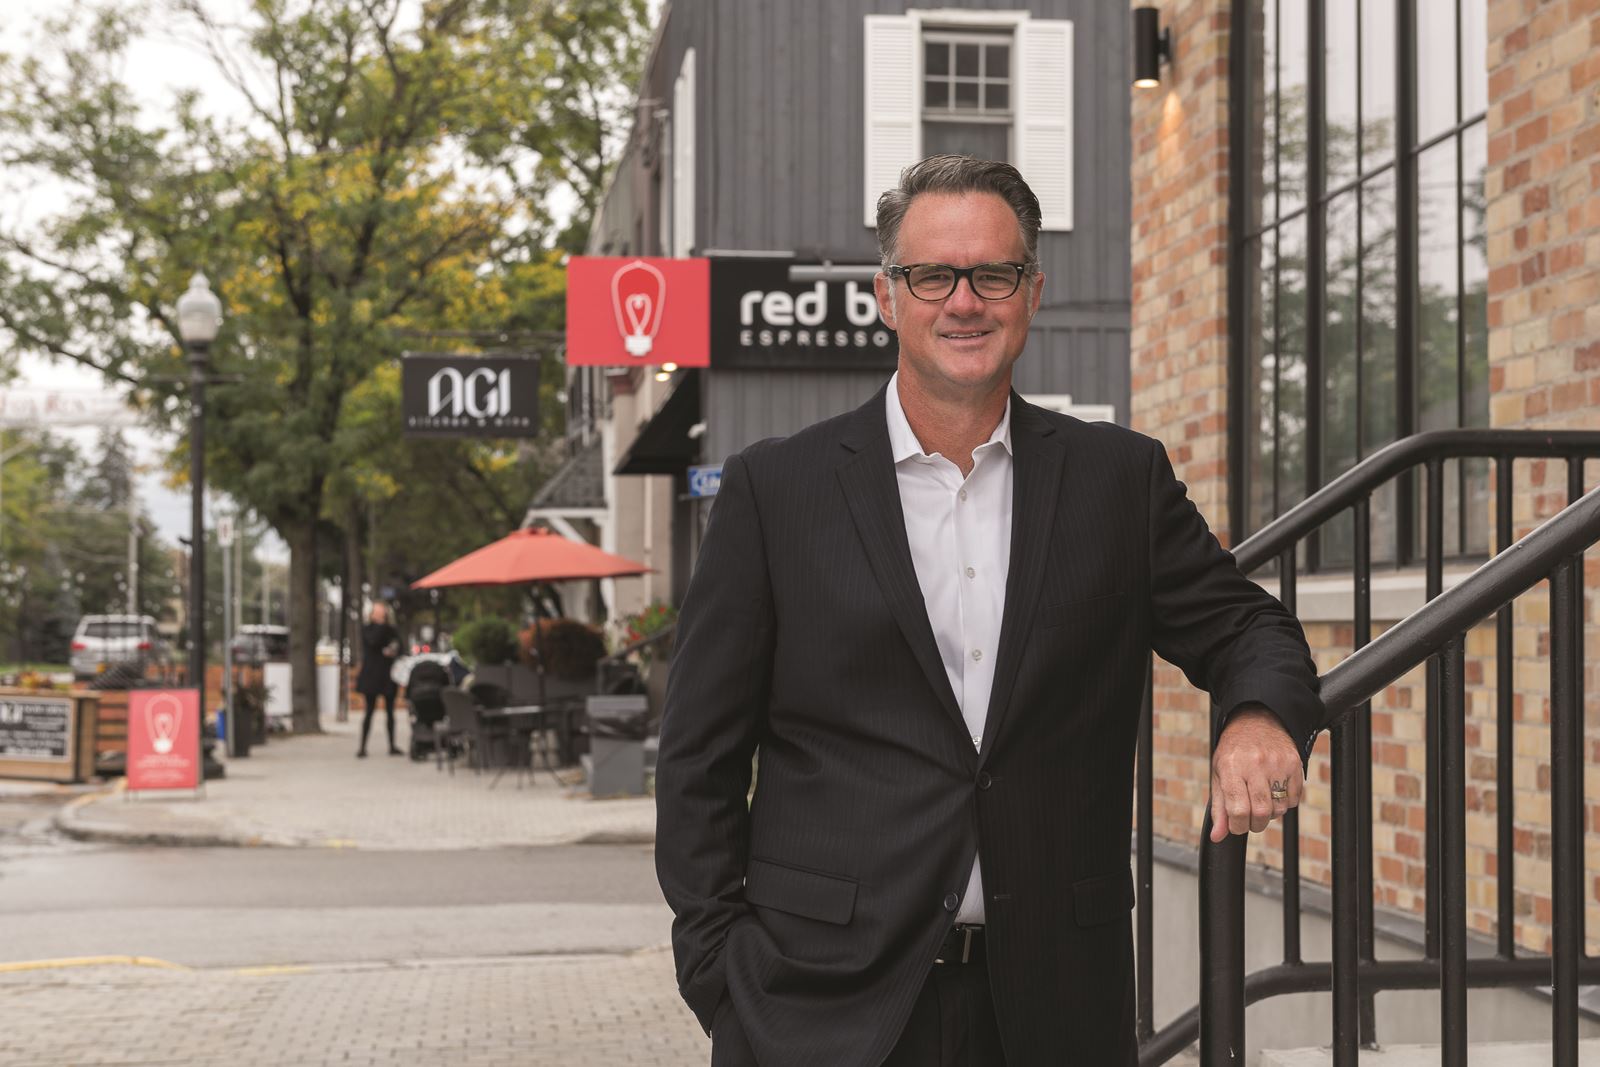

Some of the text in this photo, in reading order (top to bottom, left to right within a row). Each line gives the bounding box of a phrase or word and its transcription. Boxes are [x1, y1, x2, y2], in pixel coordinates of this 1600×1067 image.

[740, 280, 828, 326] red
[740, 330, 890, 347] ESPRESSO
[427, 366, 511, 418] AGI
